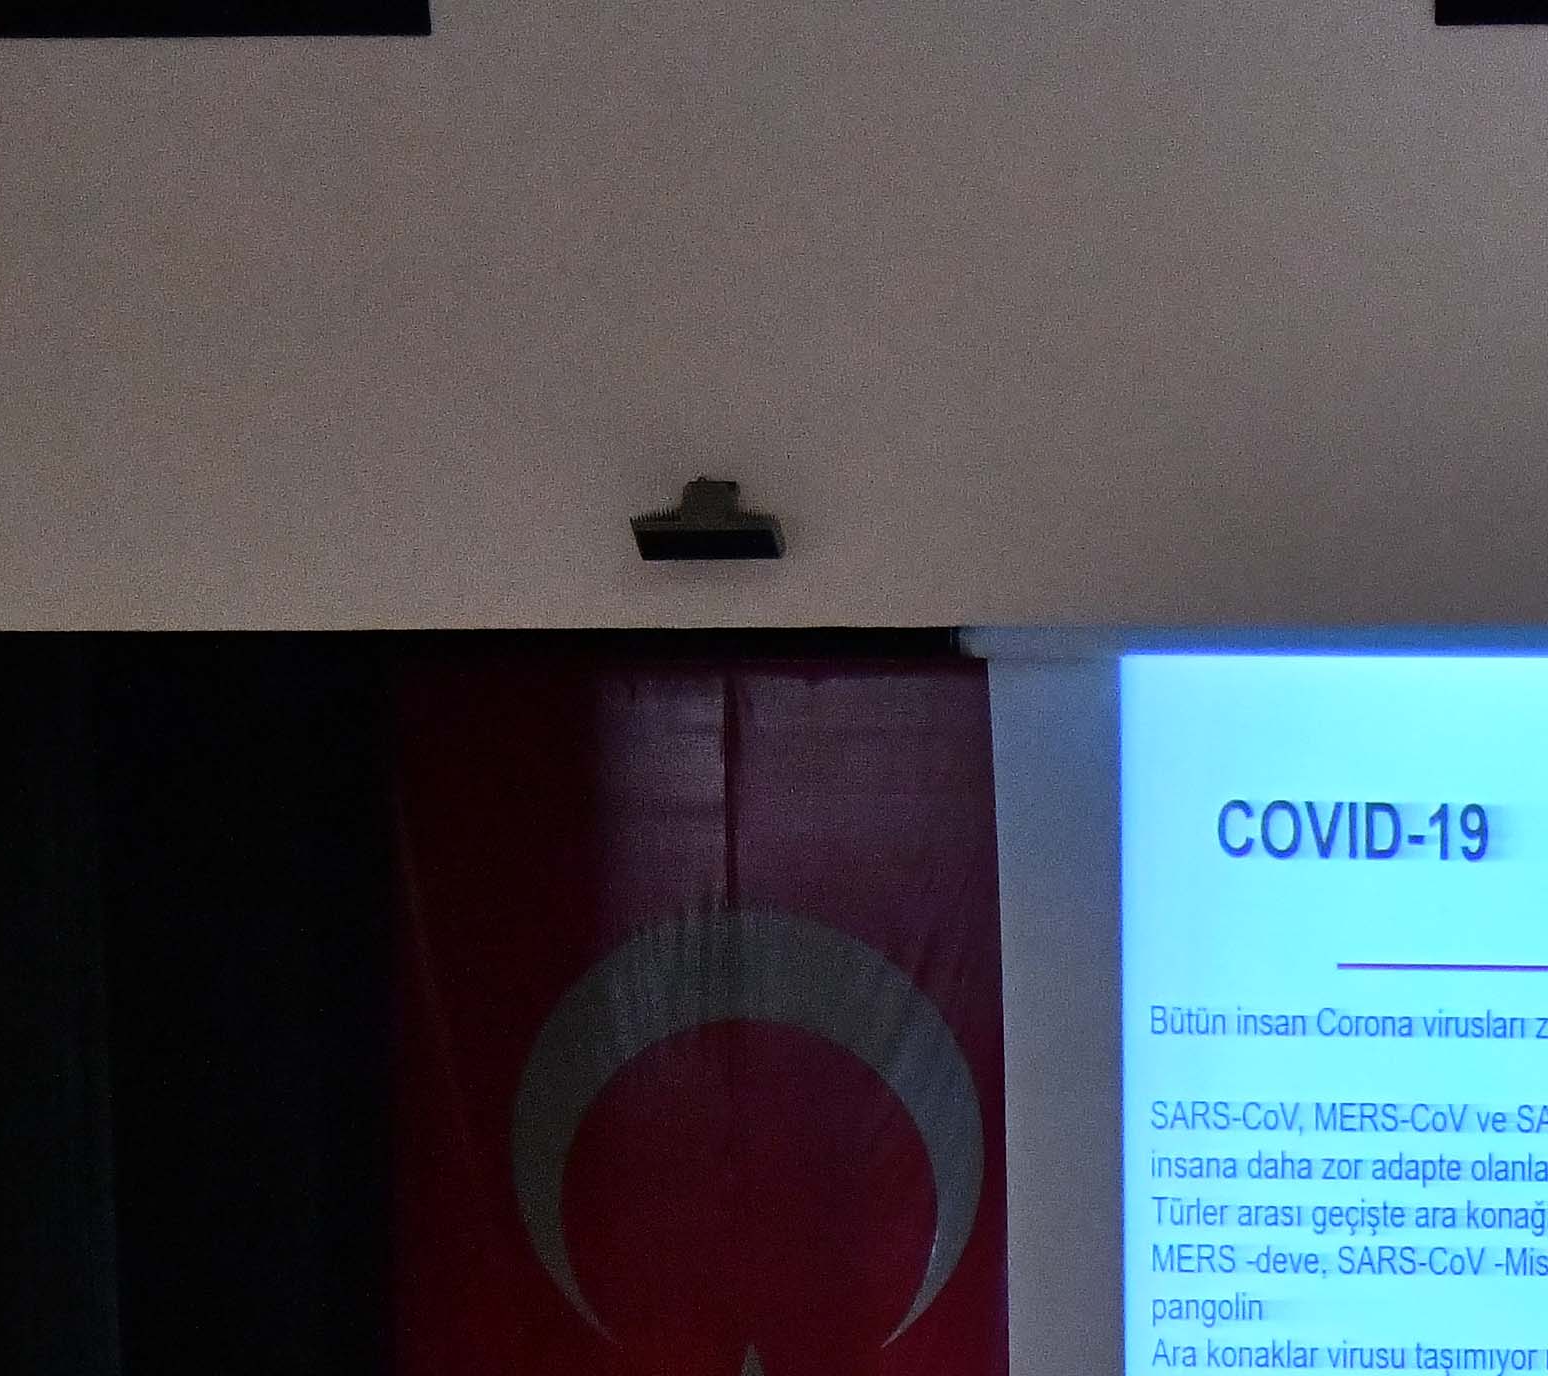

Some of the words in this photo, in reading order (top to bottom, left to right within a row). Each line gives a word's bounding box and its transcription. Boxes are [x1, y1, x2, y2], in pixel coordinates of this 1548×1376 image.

[1217, 797, 1490, 859] COVID-19
[1150, 1003, 1226, 1034] Bütün
[1236, 1008, 1306, 1036] insan
[1317, 1007, 1413, 1037] Corona
[1423, 1009, 1525, 1038] virusları
[1151, 1100, 1305, 1134] SARS-CoV,
[1314, 1101, 1466, 1131] MERS-CoV
[1476, 1109, 1508, 1132] ve
[1151, 1149, 1237, 1179] insana
[1246, 1150, 1312, 1180] daha
[1322, 1157, 1362, 1180] zor
[1372, 1152, 1461, 1188] adapte
[1152, 1194, 1227, 1225] Türler
[1238, 1202, 1302, 1227] arası
[1312, 1198, 1405, 1235] geçişte
[1415, 1204, 1456, 1228] ara
[1152, 1244, 1235, 1273] MERS
[1337, 1245, 1483, 1275] SARS-CoV
[1152, 1292, 1263, 1328] pangolin
[1152, 1338, 1197, 1367] Ara
[1206, 1338, 1317, 1368] konaklar
[1327, 1340, 1405, 1369] virusu
